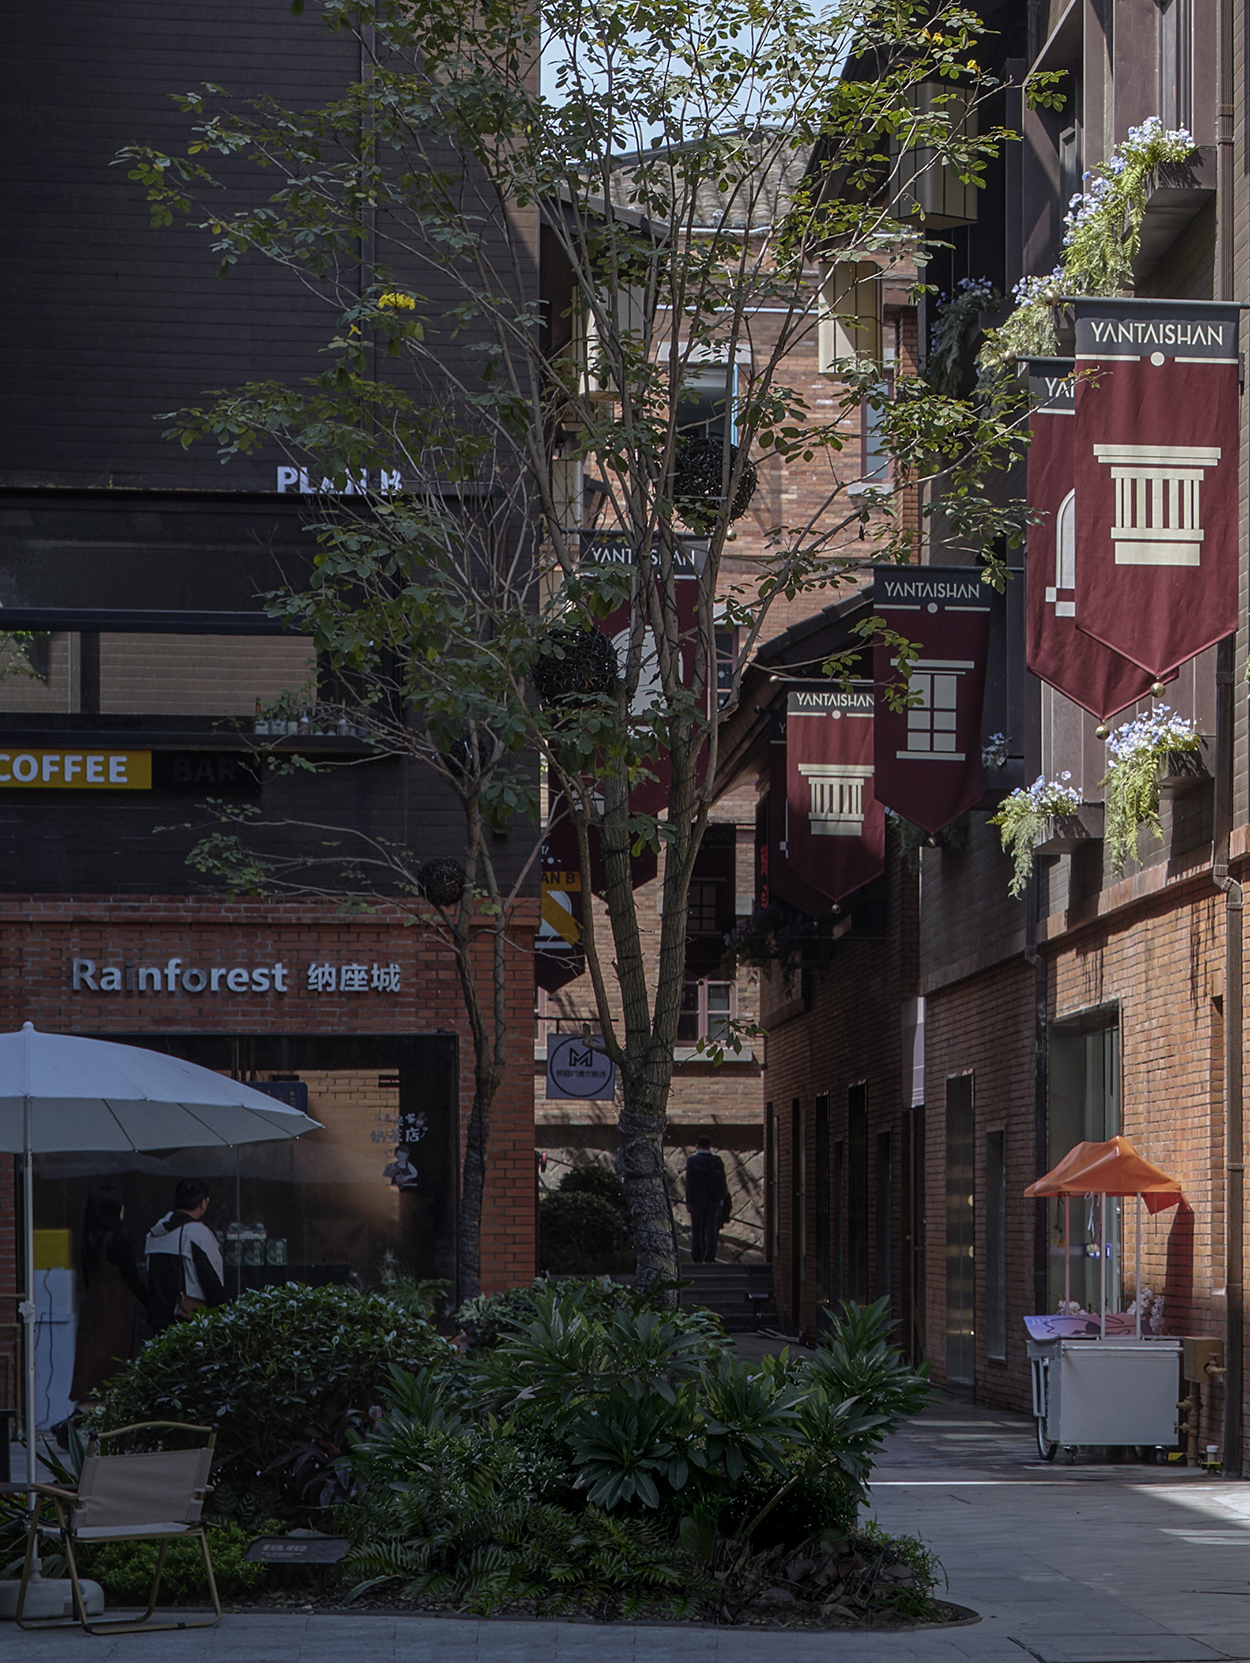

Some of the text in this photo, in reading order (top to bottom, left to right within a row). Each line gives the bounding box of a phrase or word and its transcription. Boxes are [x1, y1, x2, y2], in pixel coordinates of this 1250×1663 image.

[1090, 321, 1224, 346] YANTAISHAN
[884, 581, 980, 599] YANTAISHAN
[796, 692, 875, 707] YANTAISHAN
[171, 756, 239, 784] BAR
[565, 871, 576, 885] B
[70, 957, 401, 993] Rainforest 纳座城
